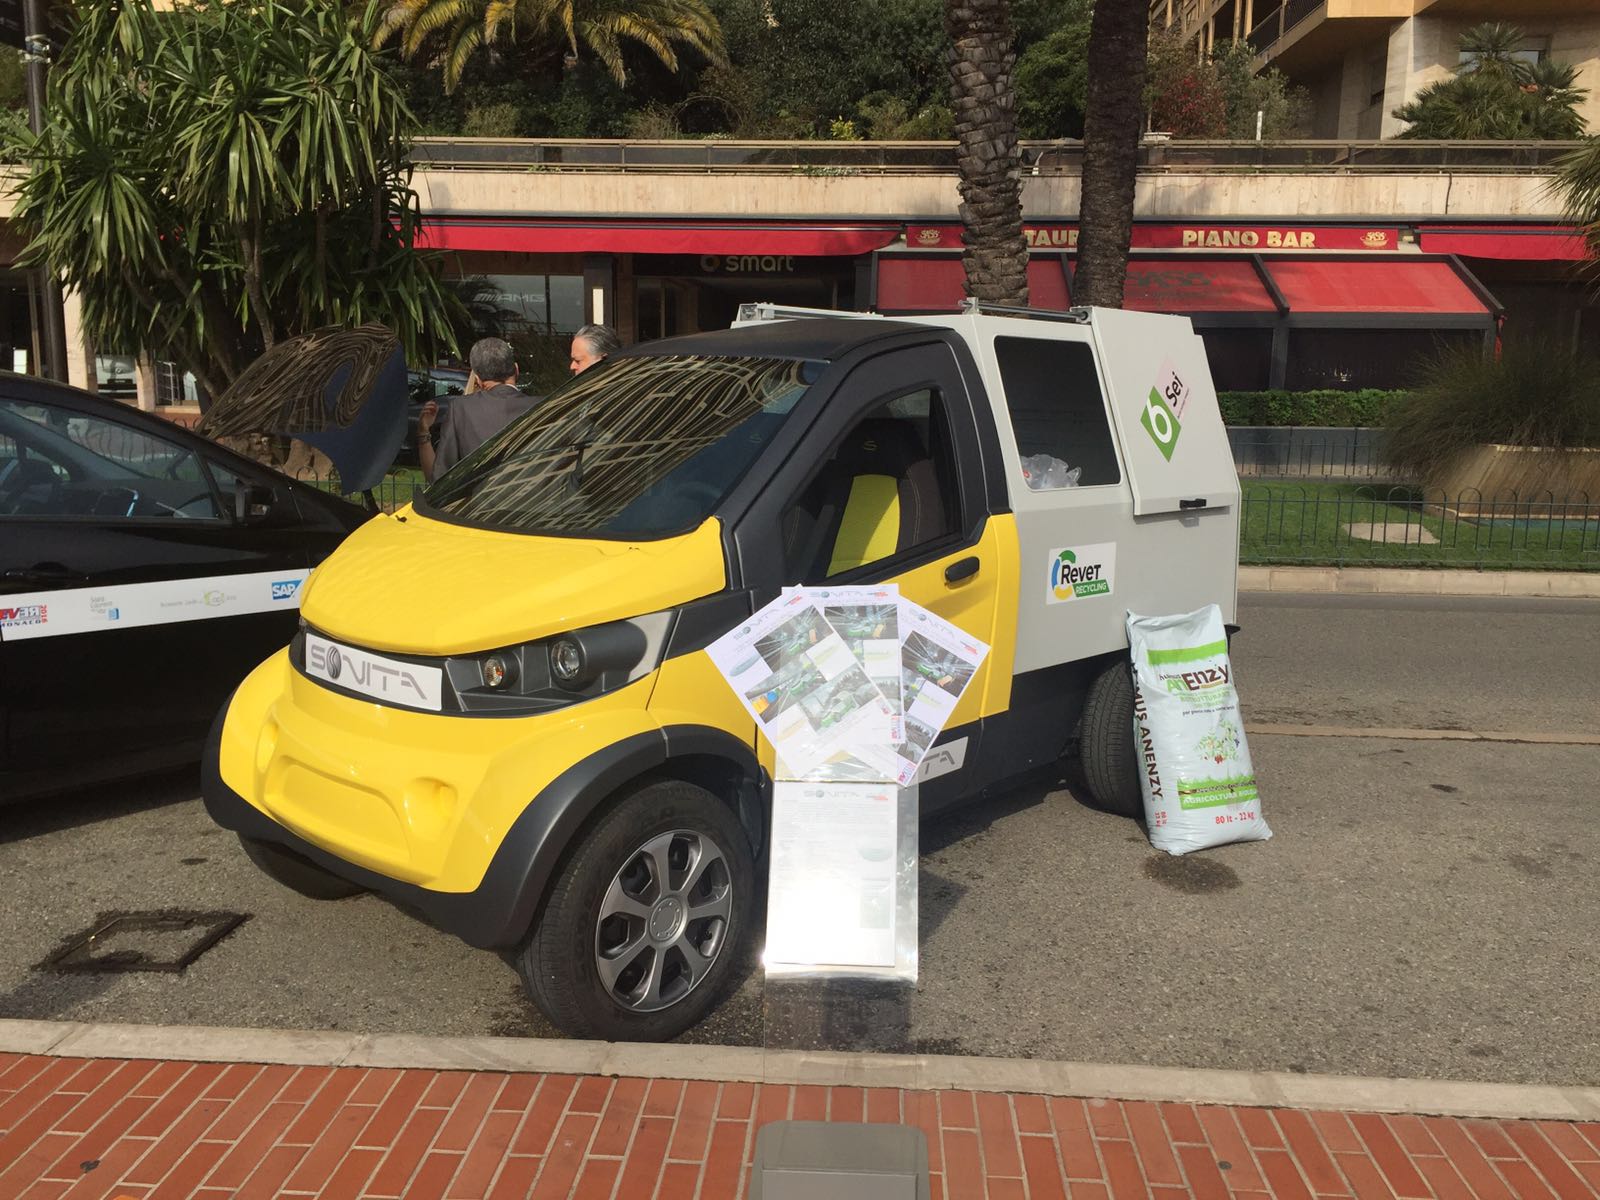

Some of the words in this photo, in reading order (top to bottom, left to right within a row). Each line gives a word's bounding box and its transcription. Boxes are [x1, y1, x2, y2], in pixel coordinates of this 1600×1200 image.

[1182, 230, 1259, 247] PIANO
[1267, 231, 1316, 248] BAR
[725, 255, 794, 272] smart
[496, 293, 545, 303] AMG
[273, 584, 296, 597] SAP
[1076, 582, 1107, 593] RECYCLING
[311, 644, 428, 701] SOVITA
[1140, 726, 1164, 799] ANENZY
[1215, 815, 1226, 825] 80
